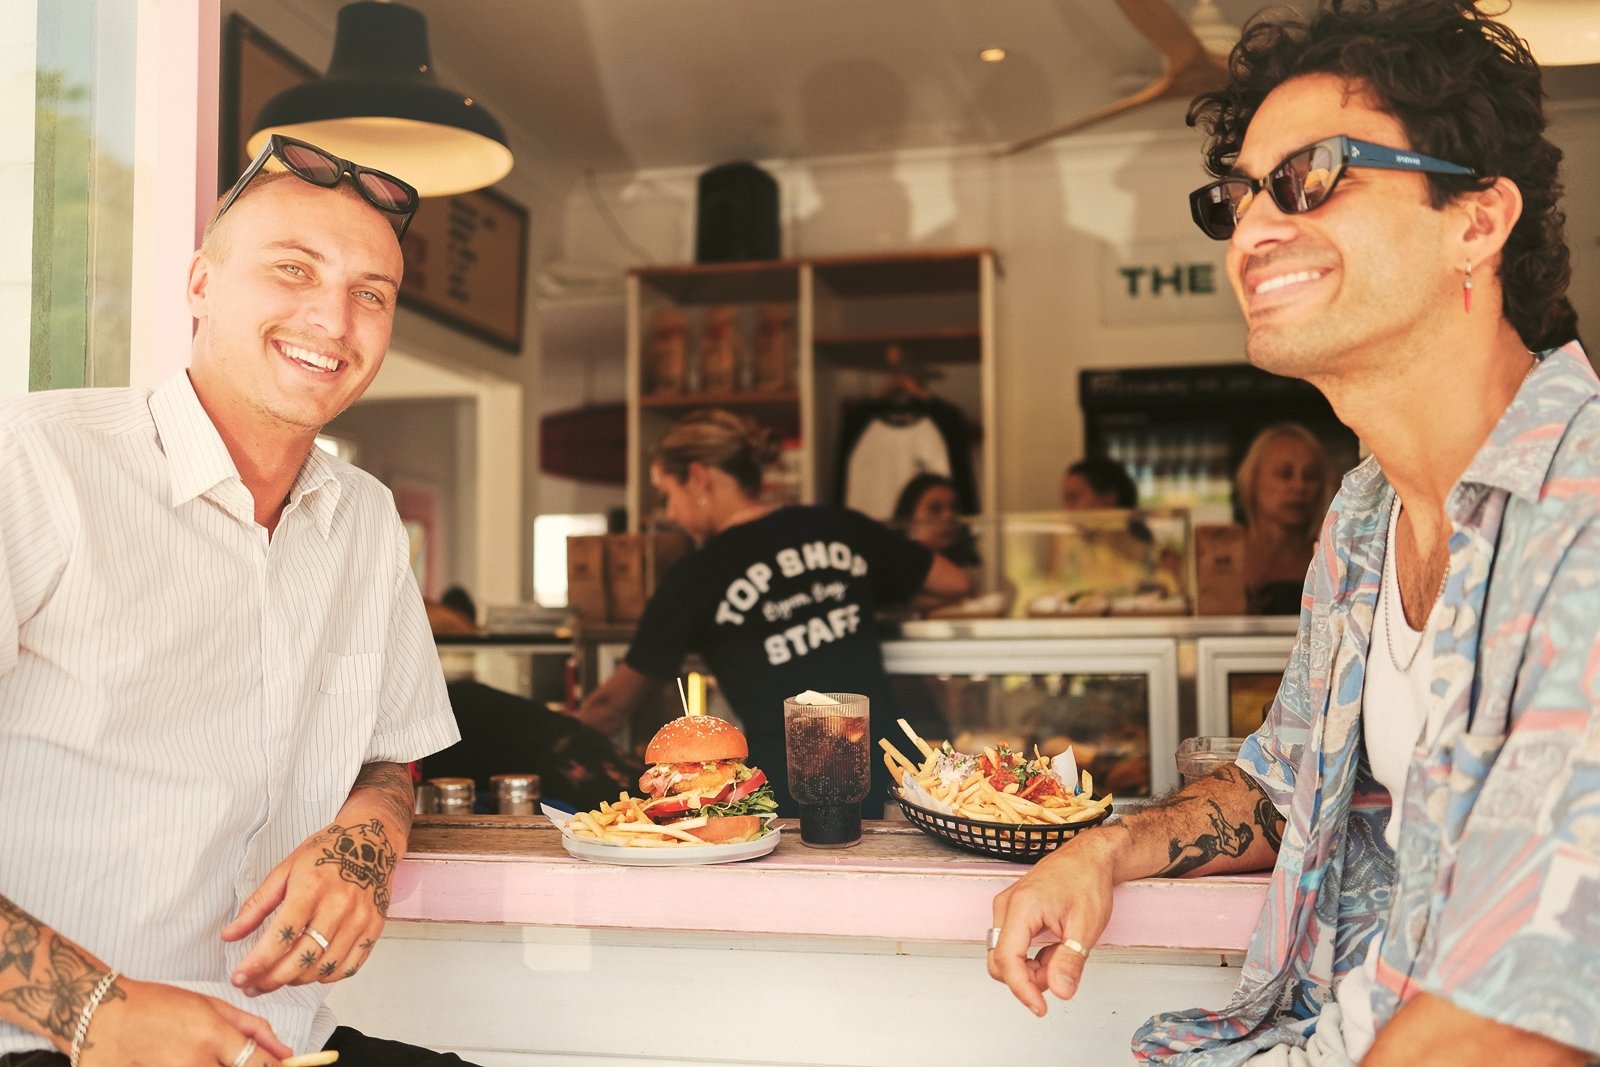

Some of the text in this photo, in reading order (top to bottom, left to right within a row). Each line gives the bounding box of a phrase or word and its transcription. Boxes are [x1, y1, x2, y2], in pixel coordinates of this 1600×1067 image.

[1120, 264, 1216, 298] THE
[715, 562, 773, 625] TOP
[764, 604, 860, 666] STAFF
